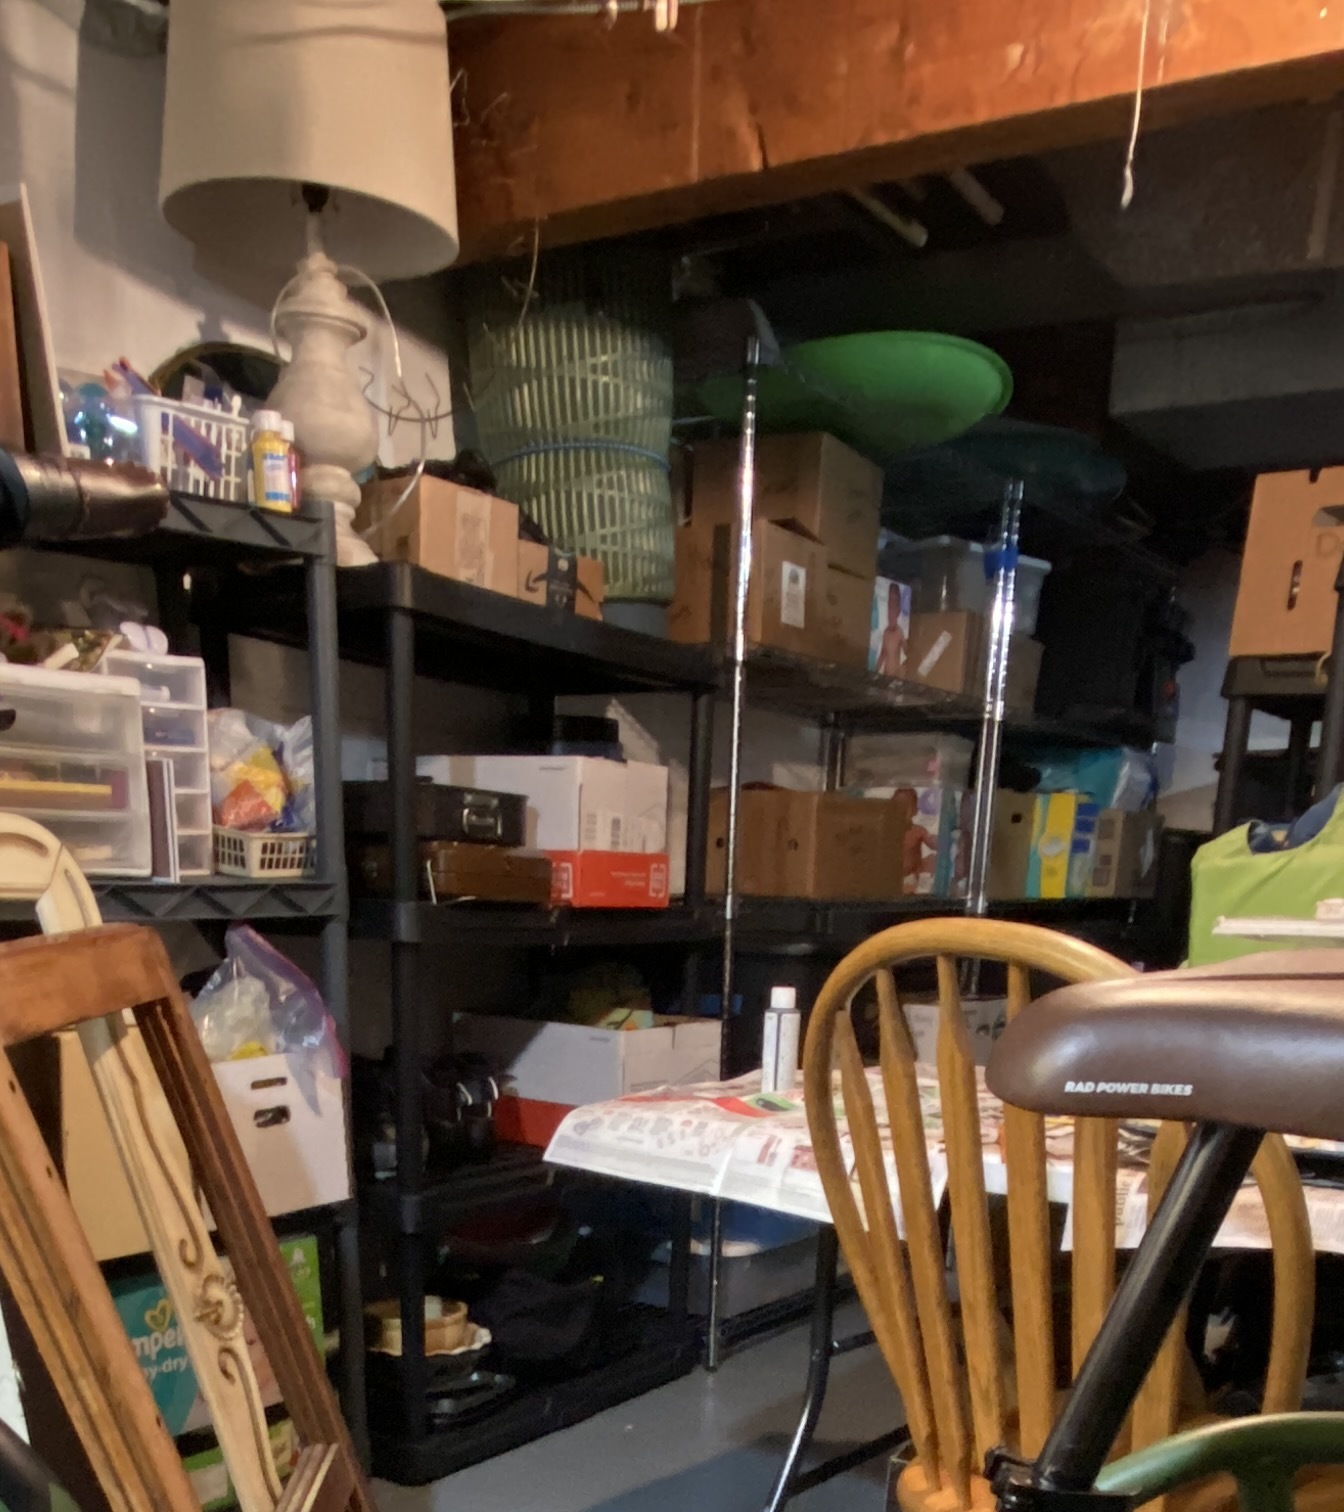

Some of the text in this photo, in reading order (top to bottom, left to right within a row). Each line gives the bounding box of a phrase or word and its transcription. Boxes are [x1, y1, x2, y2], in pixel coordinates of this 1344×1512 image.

[1064, 1081, 1193, 1096] RAD POWER BIKES
